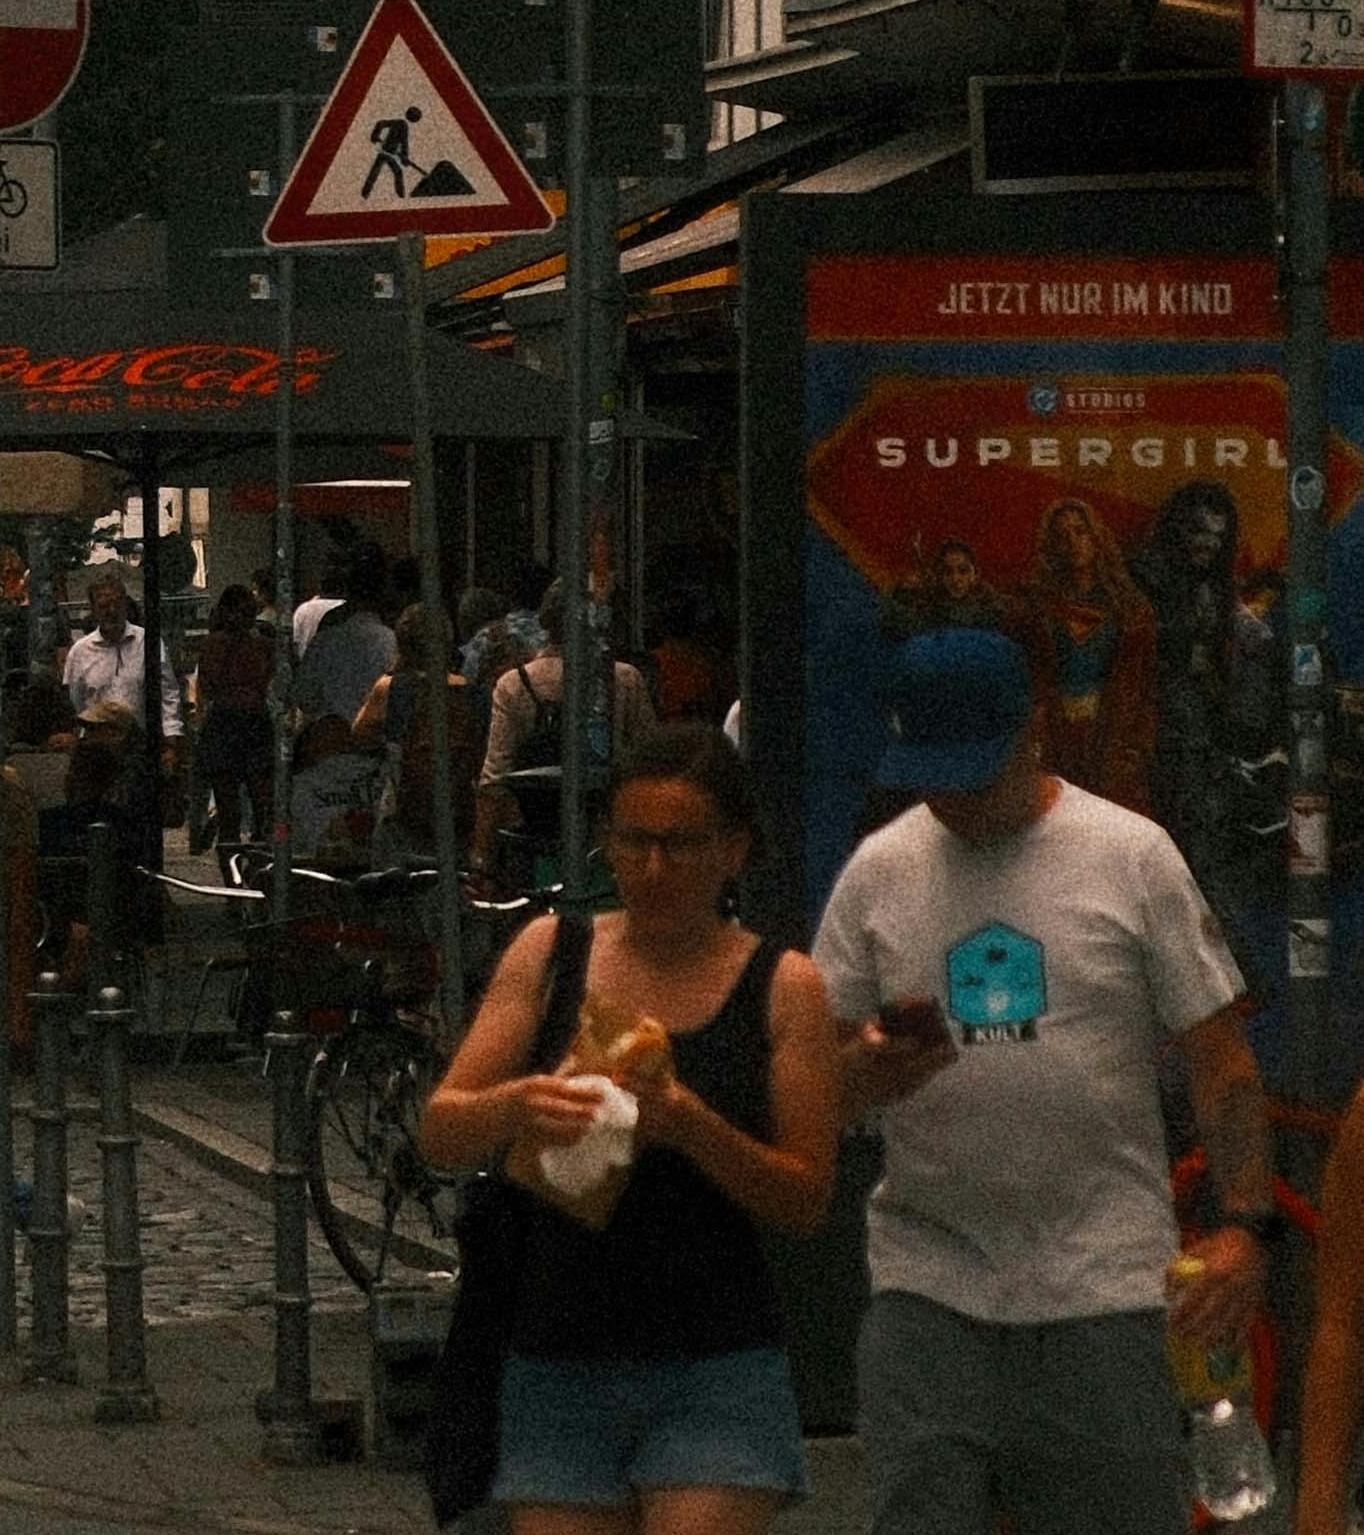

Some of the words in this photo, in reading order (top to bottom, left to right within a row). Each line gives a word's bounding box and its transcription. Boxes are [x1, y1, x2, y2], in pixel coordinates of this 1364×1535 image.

[938, 283, 1031, 315] JETZT
[1039, 283, 1102, 315] NUR
[1111, 283, 1149, 315] IM
[1158, 283, 1232, 315] KINO
[876, 437, 1288, 468] SUPERGIRL
